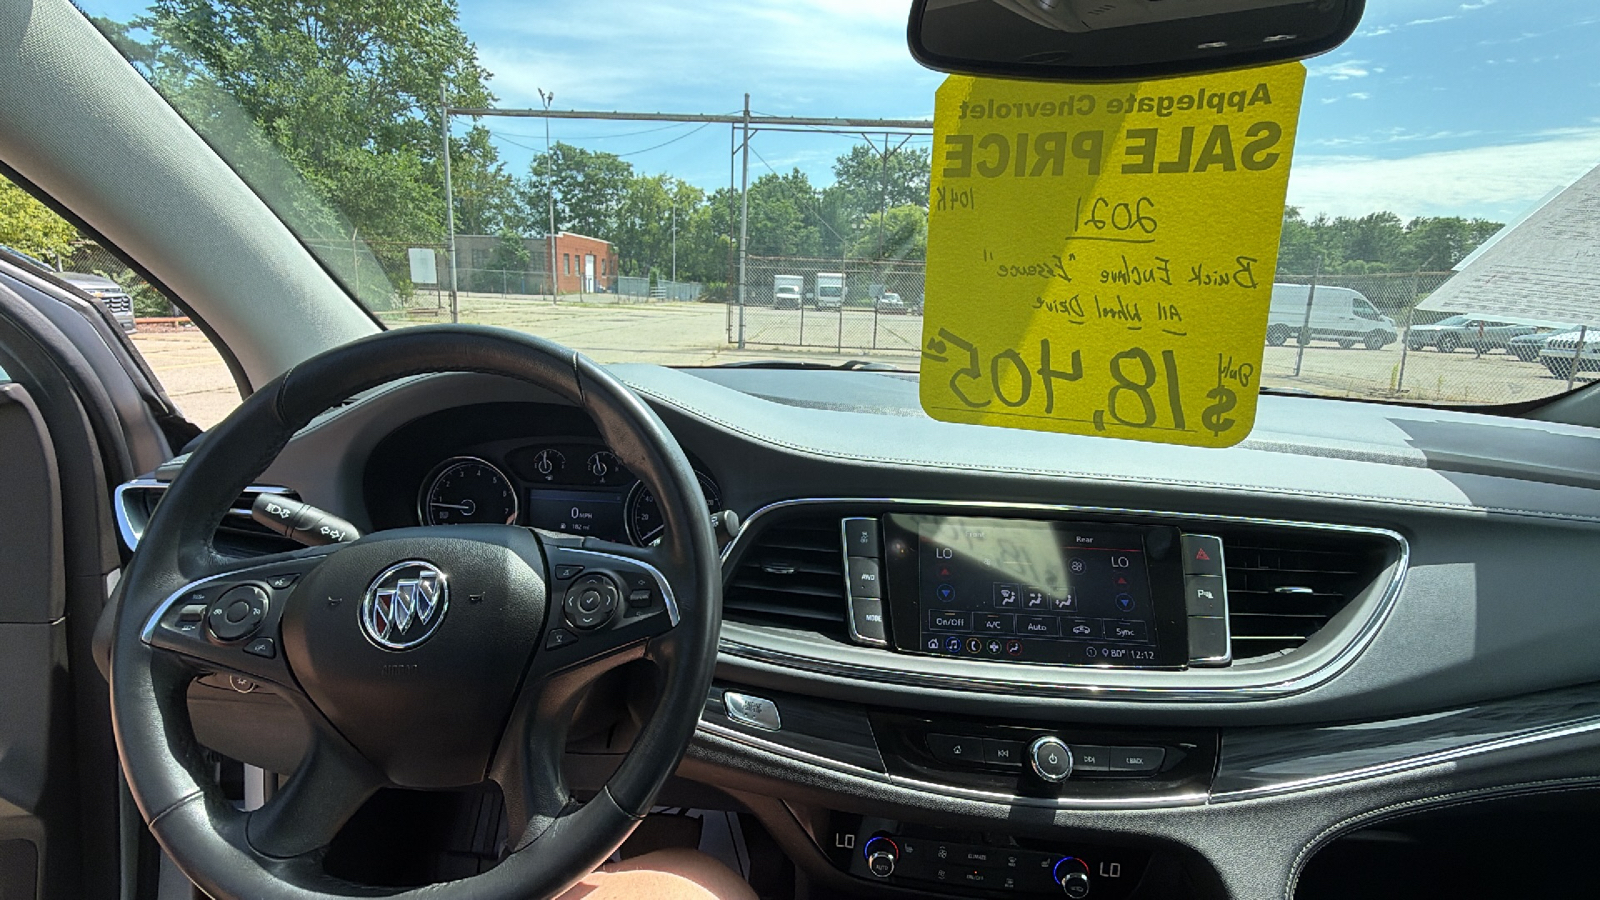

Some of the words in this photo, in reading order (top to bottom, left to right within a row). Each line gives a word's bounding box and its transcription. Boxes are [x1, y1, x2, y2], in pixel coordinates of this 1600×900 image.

[571, 507, 579, 519] 0
[936, 548, 953, 559] LO
[1111, 556, 1129, 568] LO
[936, 617, 965, 627] On/Off
[986, 620, 1001, 629] A/C
[1028, 623, 1047, 631] Auto
[1116, 627, 1135, 636] Sync
[1131, 650, 1155, 660] 12:12
[835, 832, 855, 849] LO
[1099, 861, 1121, 878] LO
